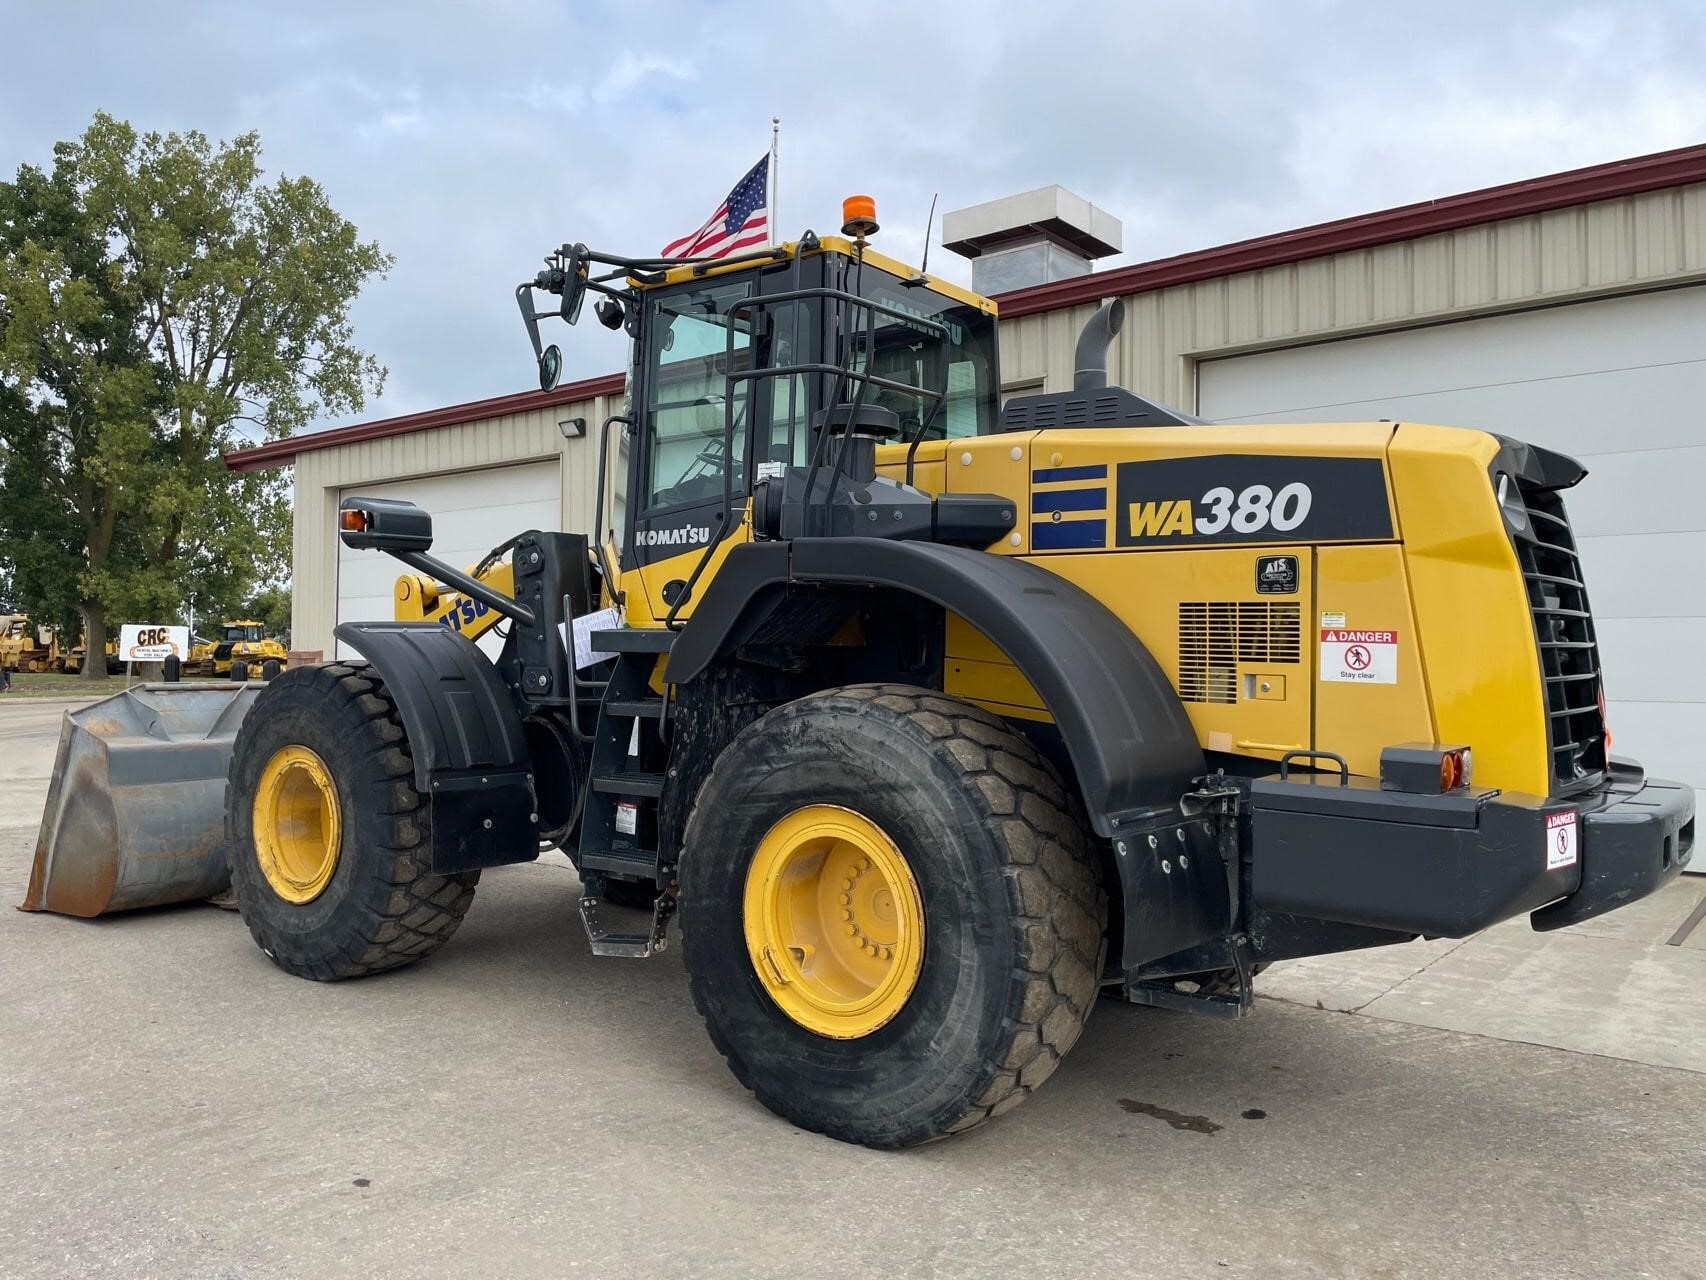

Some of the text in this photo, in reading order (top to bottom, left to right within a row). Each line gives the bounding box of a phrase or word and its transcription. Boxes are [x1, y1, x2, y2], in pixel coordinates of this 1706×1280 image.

[635, 524, 710, 546] KOMATSU
[1265, 558, 1288, 574] AIS
[137, 627, 168, 647] CRC
[1340, 631, 1392, 643] DANGER
[1340, 671, 1376, 680] Stay clear
[1551, 812, 1576, 827] DANGER
